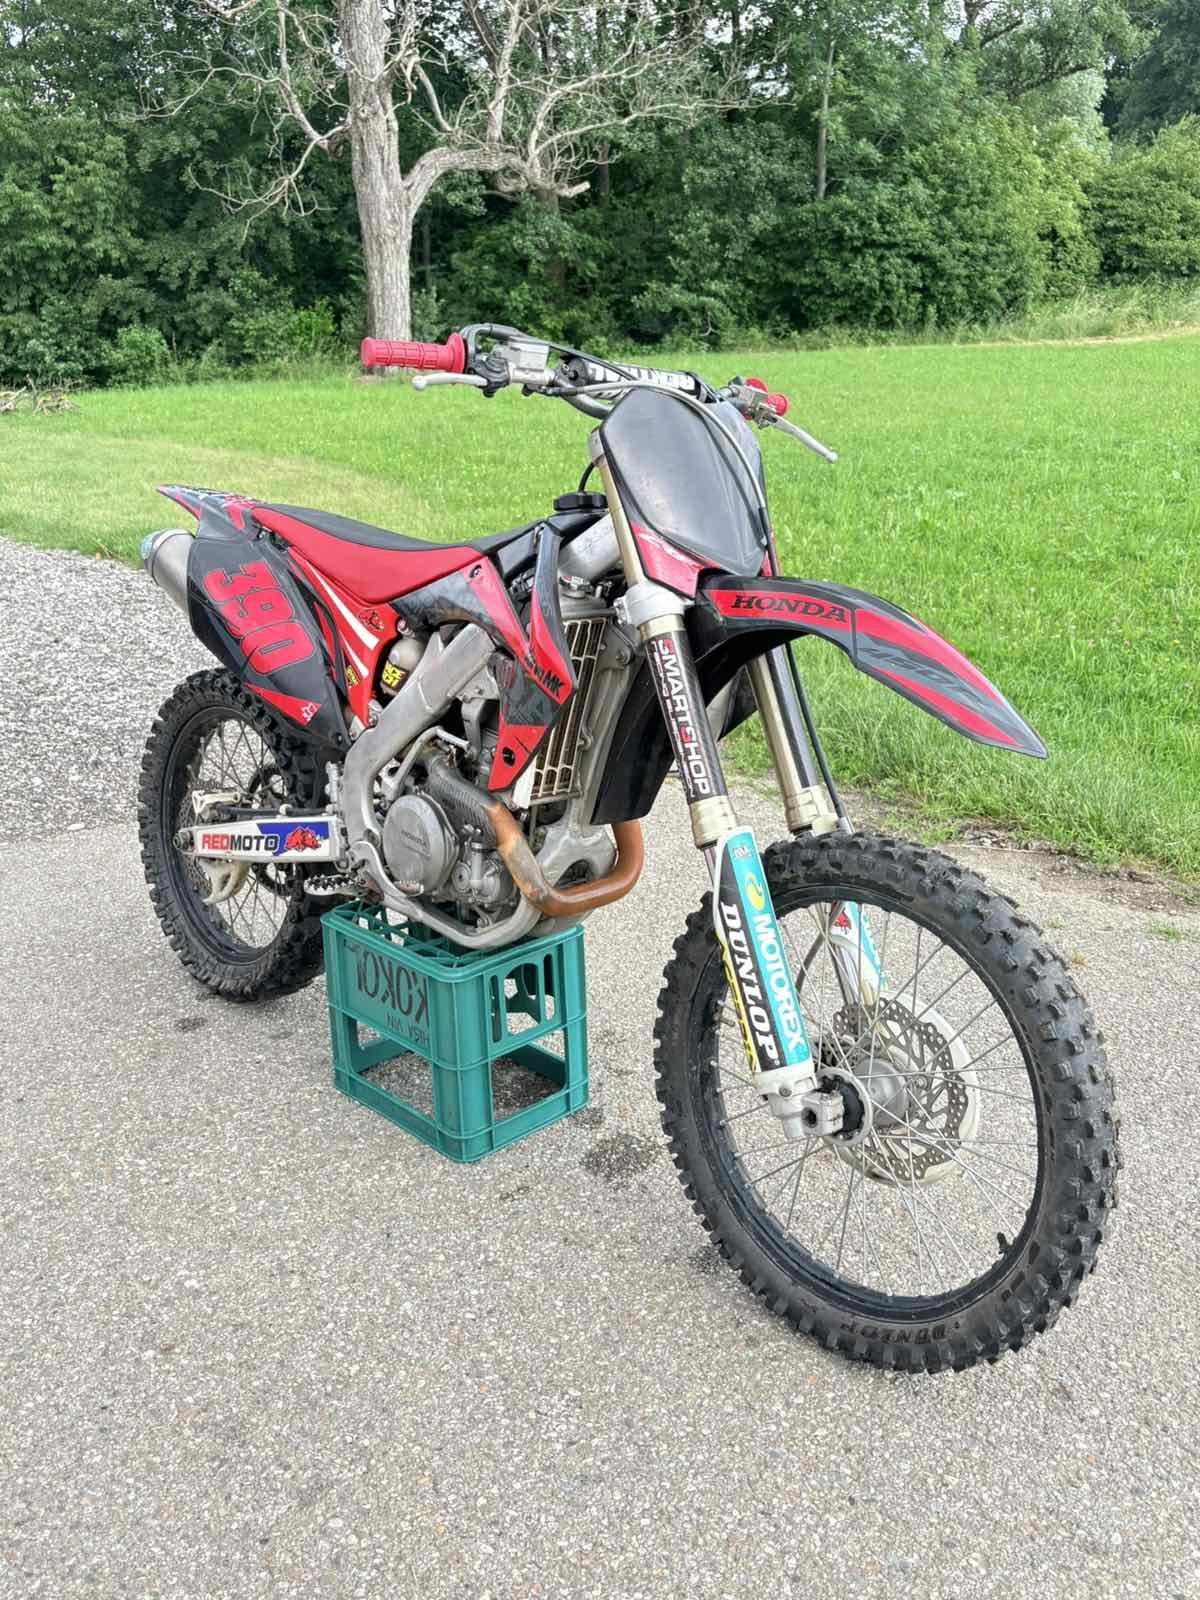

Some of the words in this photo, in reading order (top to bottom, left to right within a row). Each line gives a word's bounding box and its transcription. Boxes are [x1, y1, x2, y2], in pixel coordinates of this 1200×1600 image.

[203, 560, 315, 677] 390
[730, 593, 848, 624] HONDA
[657, 639, 711, 795] SMARTSHOP
[201, 833, 280, 853] REDMOTO
[720, 901, 780, 1066] DUNLOP
[752, 913, 806, 1052] MOTOREX
